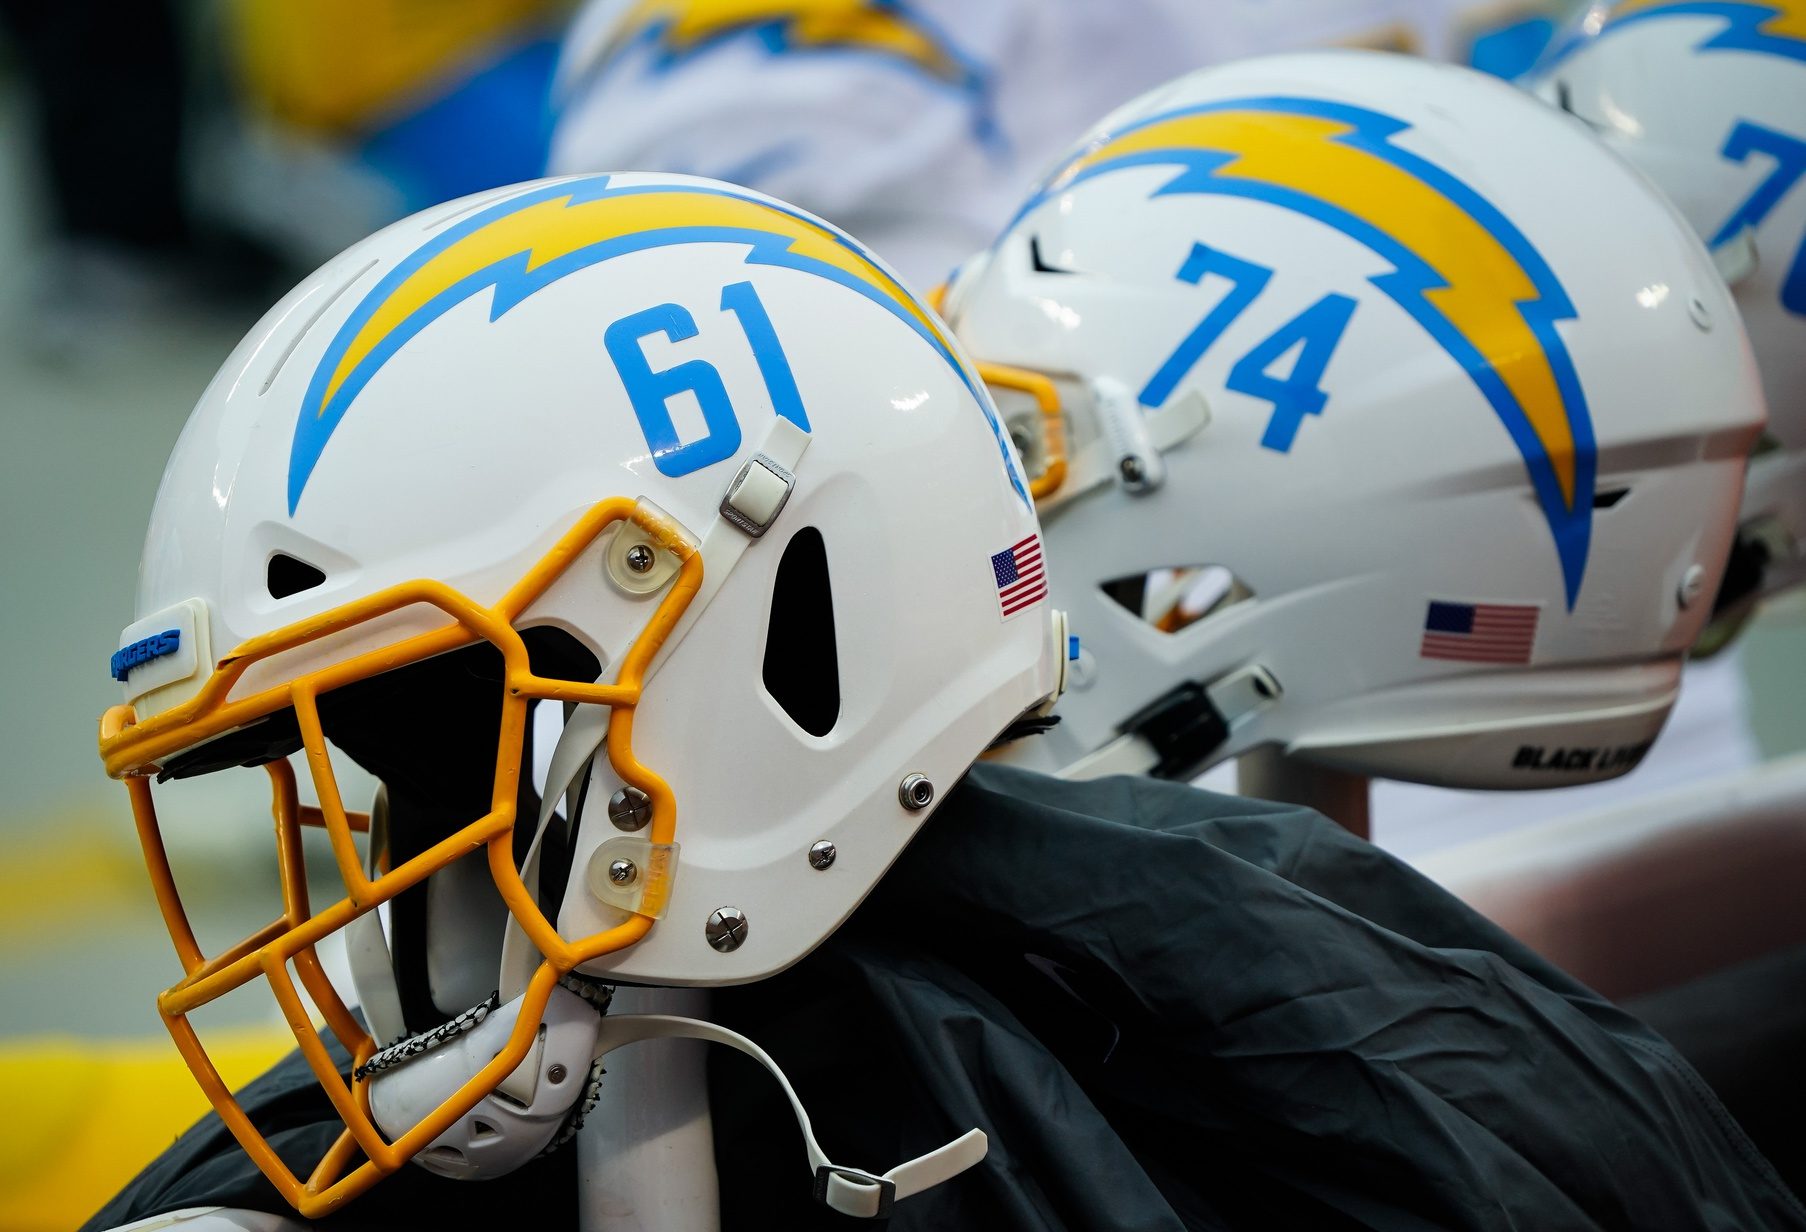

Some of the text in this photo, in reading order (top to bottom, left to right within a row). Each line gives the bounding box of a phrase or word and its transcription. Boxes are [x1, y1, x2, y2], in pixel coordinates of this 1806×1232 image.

[1705, 118, 1806, 318] 7
[604, 280, 812, 479] 61
[1137, 241, 1359, 454] 74
[1512, 745, 1597, 769] BLACK
